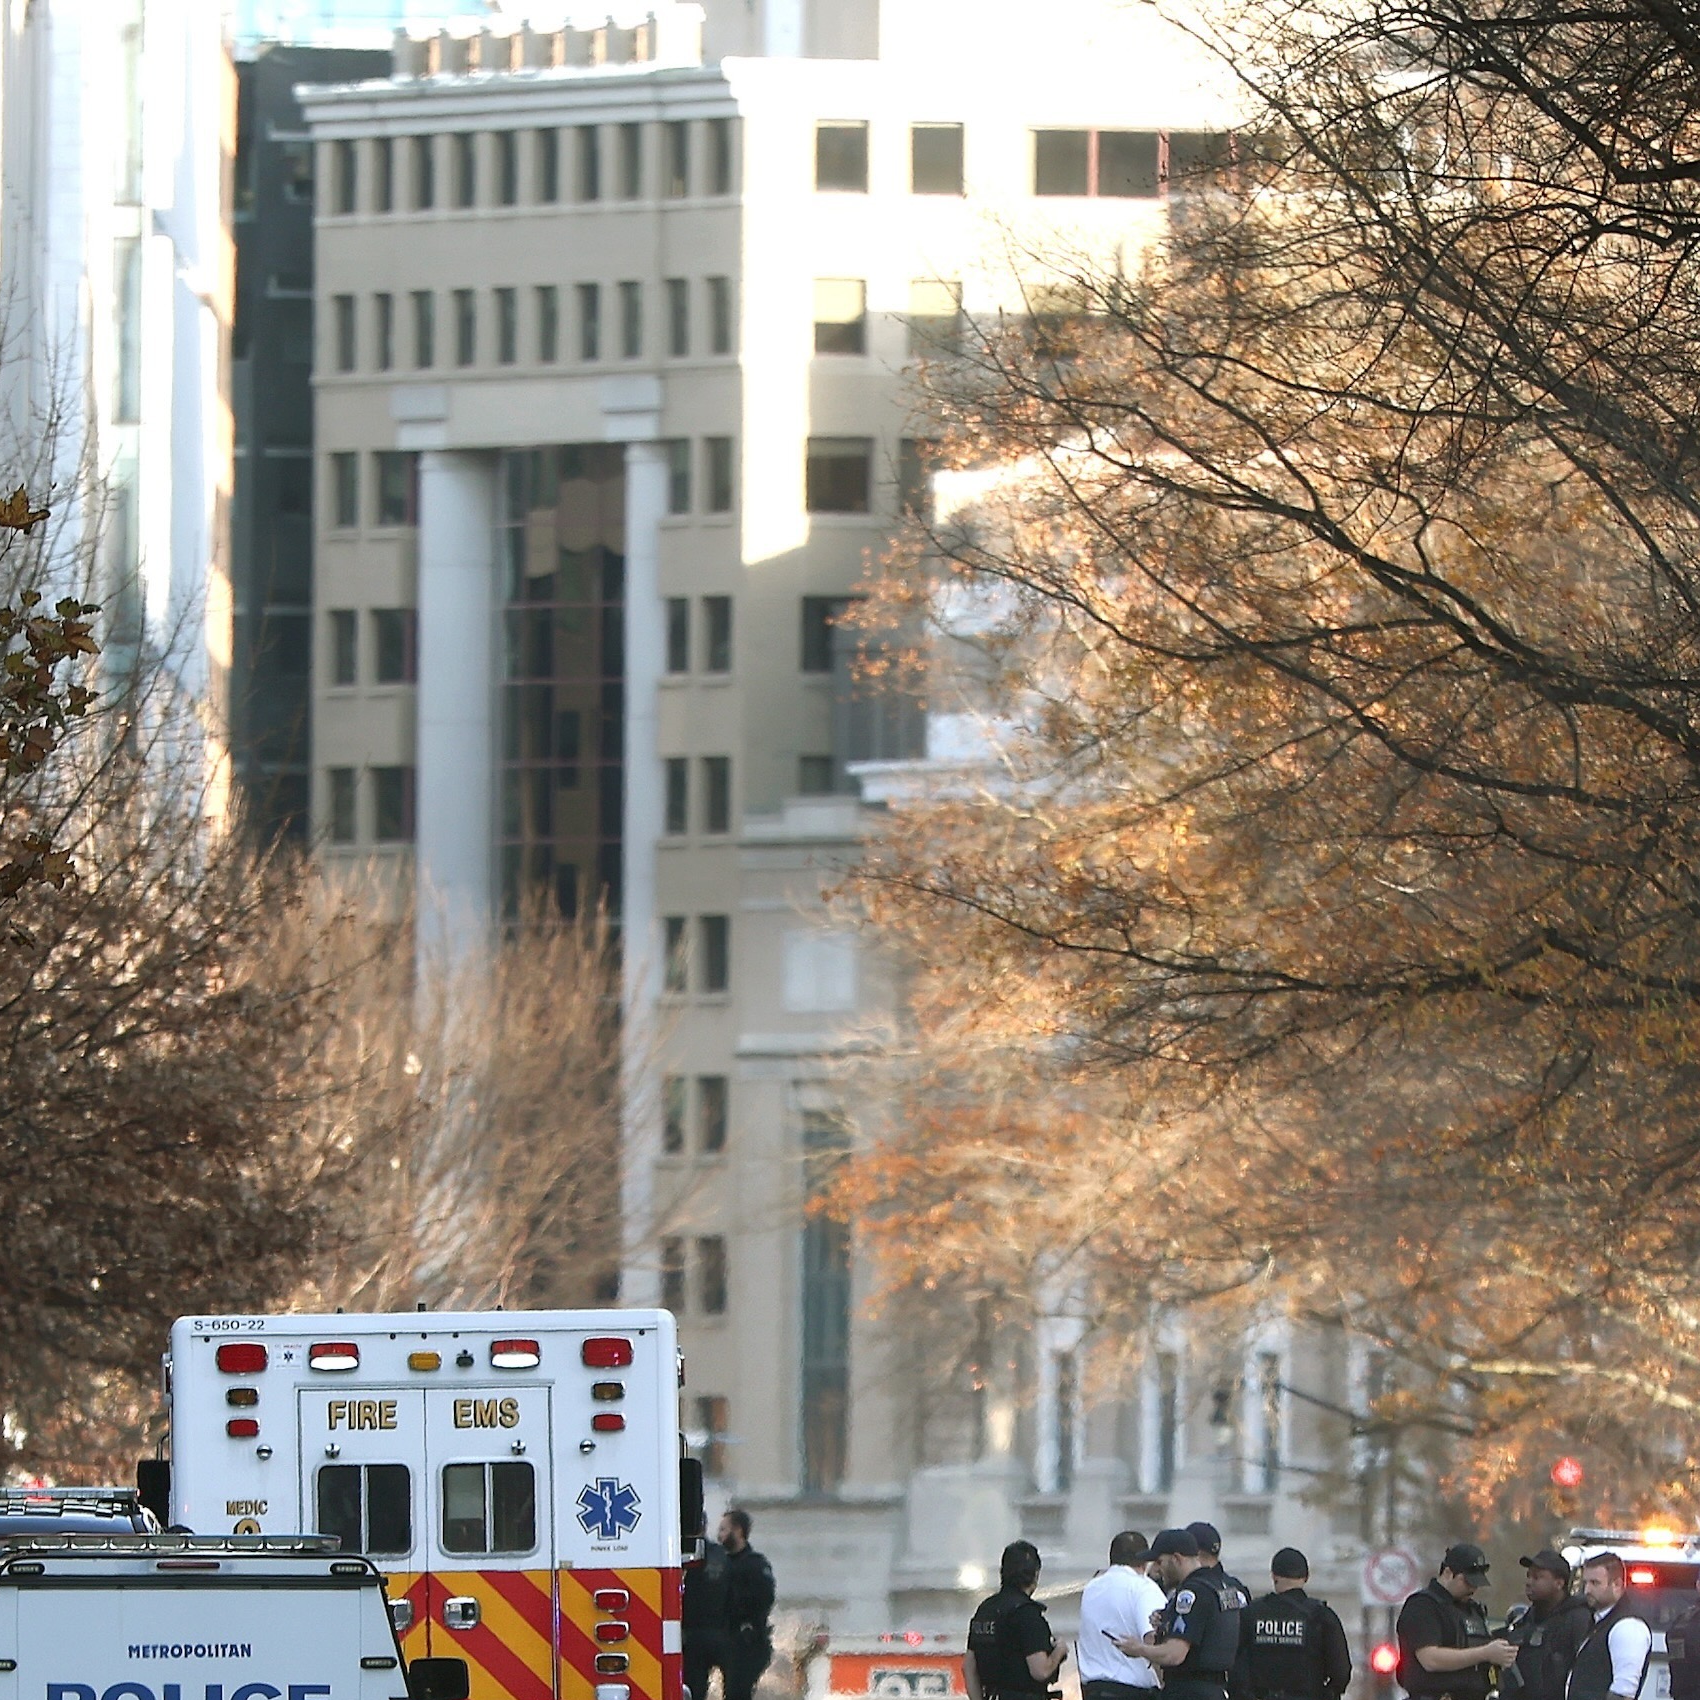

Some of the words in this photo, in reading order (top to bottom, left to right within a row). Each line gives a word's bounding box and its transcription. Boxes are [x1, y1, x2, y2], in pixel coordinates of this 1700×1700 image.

[193, 1319, 266, 1331] S-650-22
[328, 1399, 398, 1431] FIRE
[453, 1398, 520, 1430] EMS
[227, 1500, 268, 1515] MEDIC
[1256, 1620, 1303, 1637] POLICE
[127, 1643, 252, 1659] METROPOLITAN
